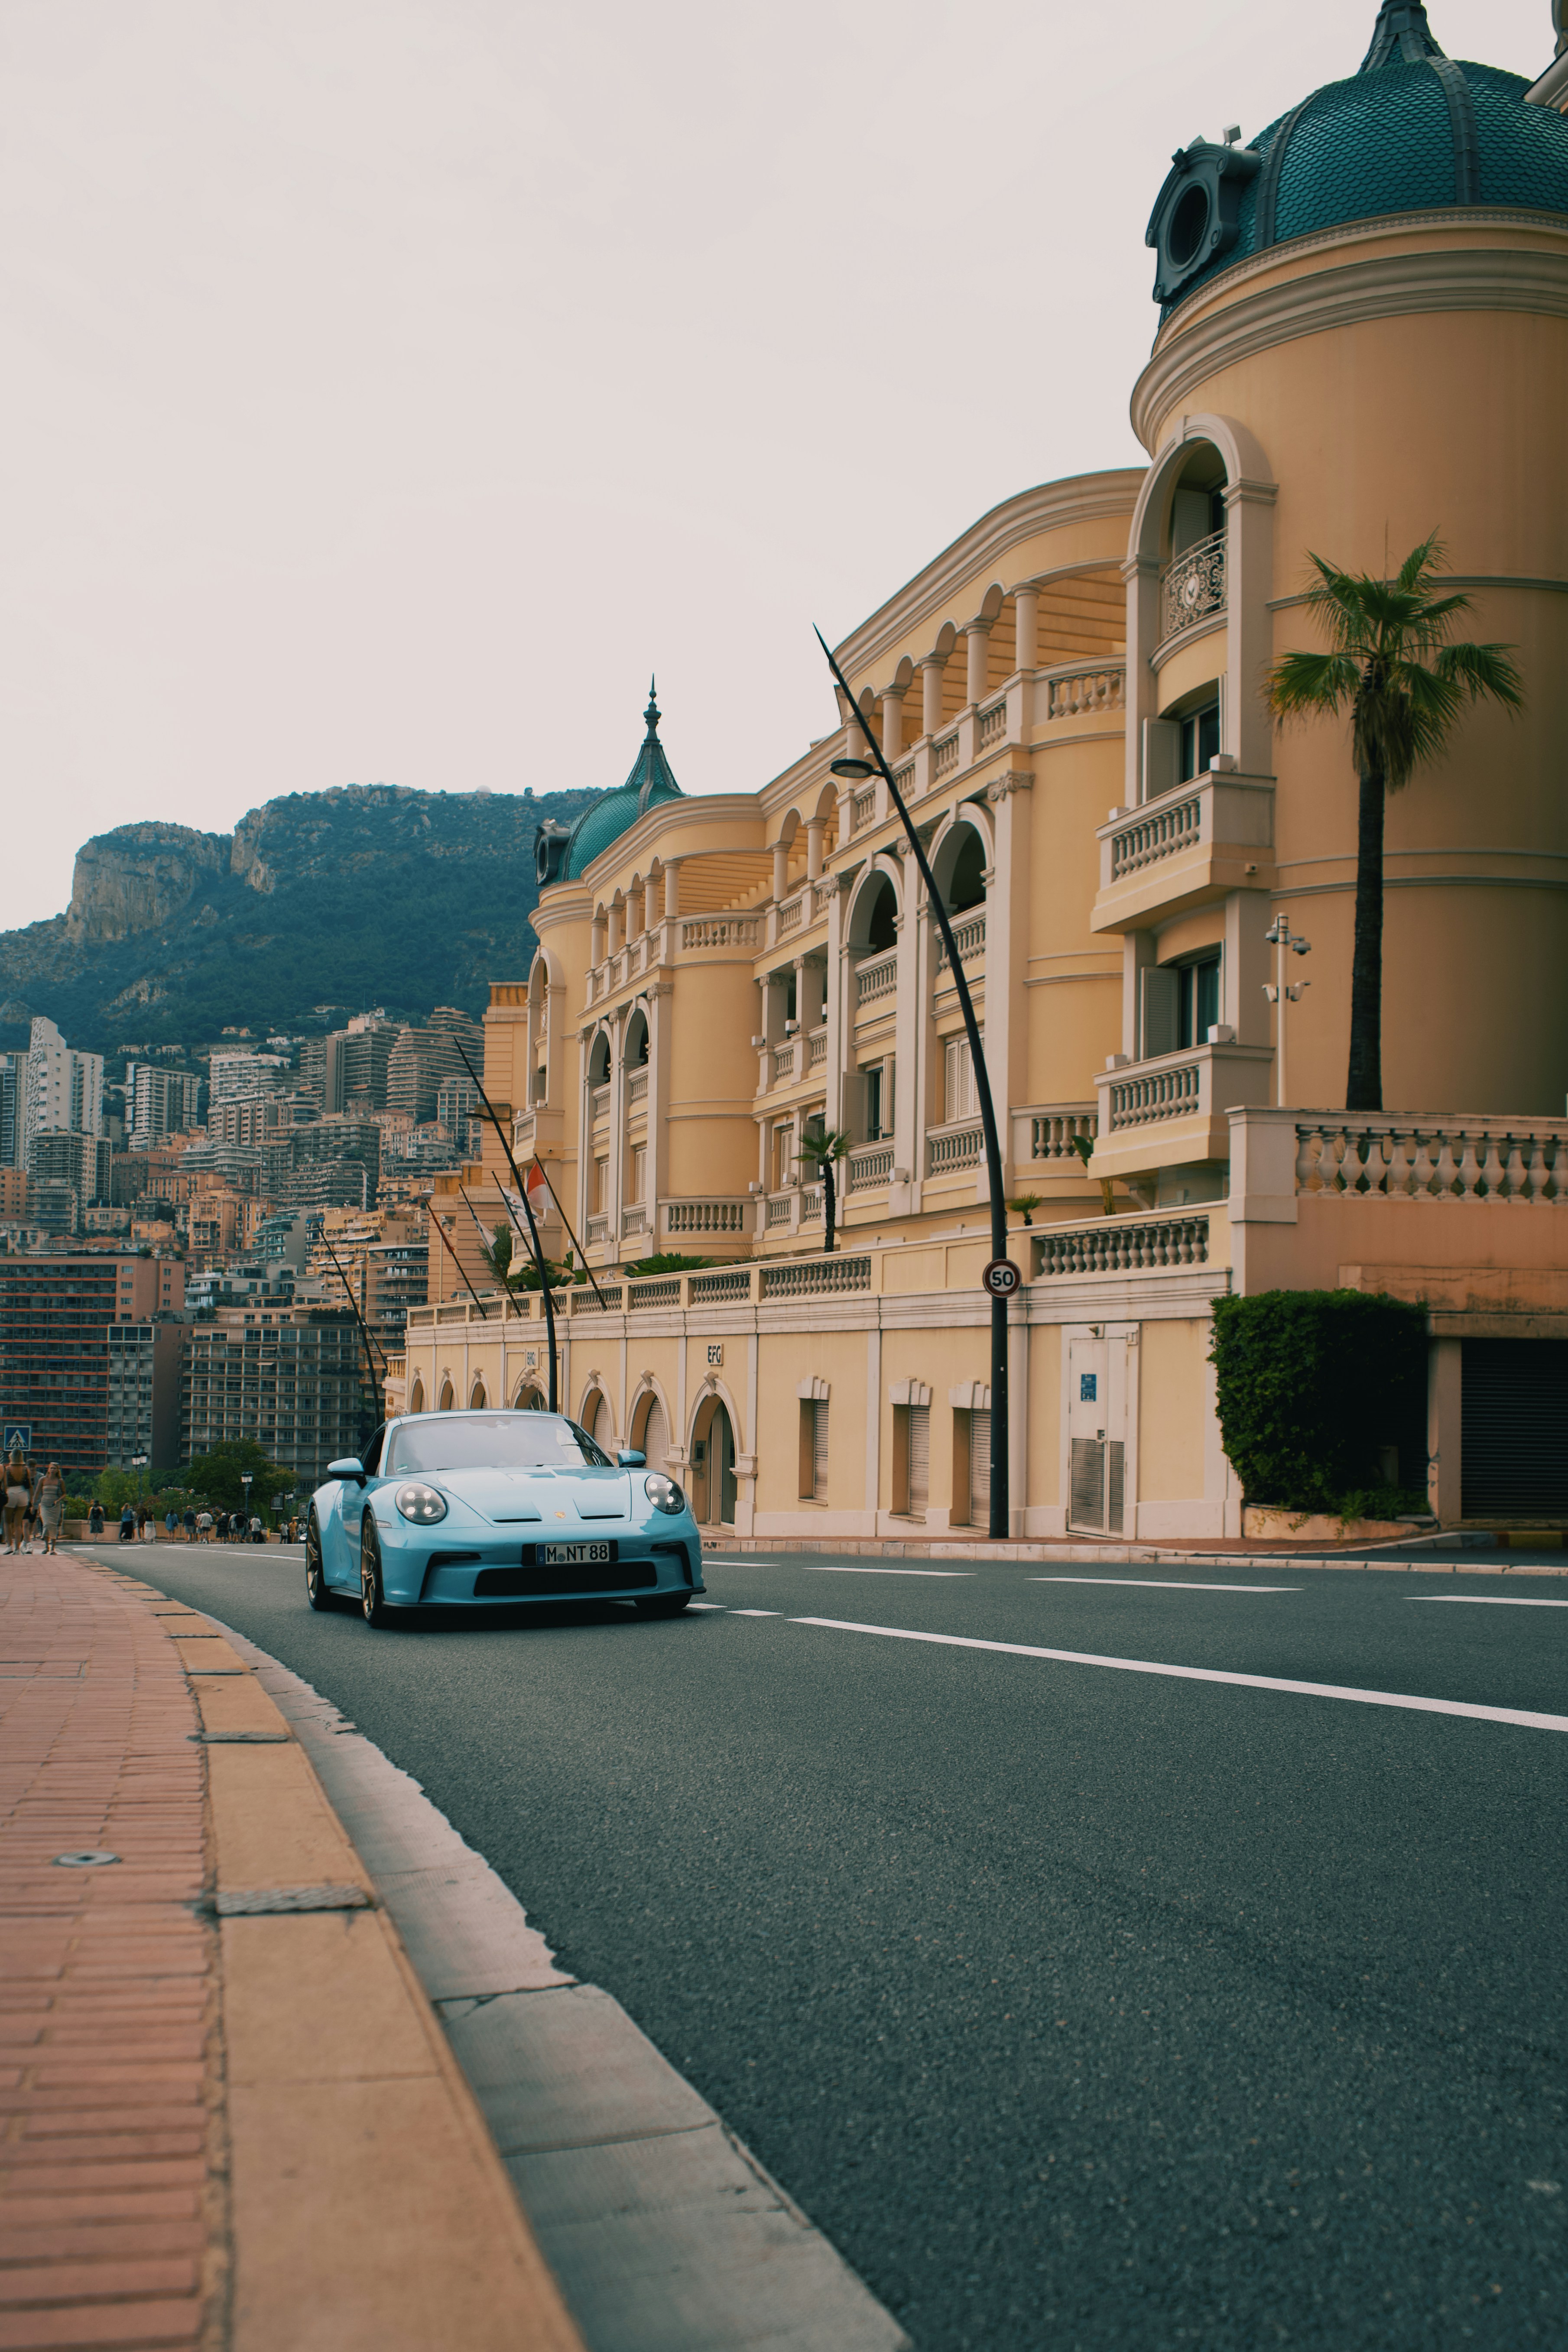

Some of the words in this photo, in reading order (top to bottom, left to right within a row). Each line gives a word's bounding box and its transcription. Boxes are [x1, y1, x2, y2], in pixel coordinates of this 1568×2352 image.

[992, 1271, 1014, 1286] 50
[708, 1345, 721, 1363] EFG
[547, 1547, 556, 1562] M
[567, 1545, 586, 1561] NT
[590, 1544, 608, 1560] 88
